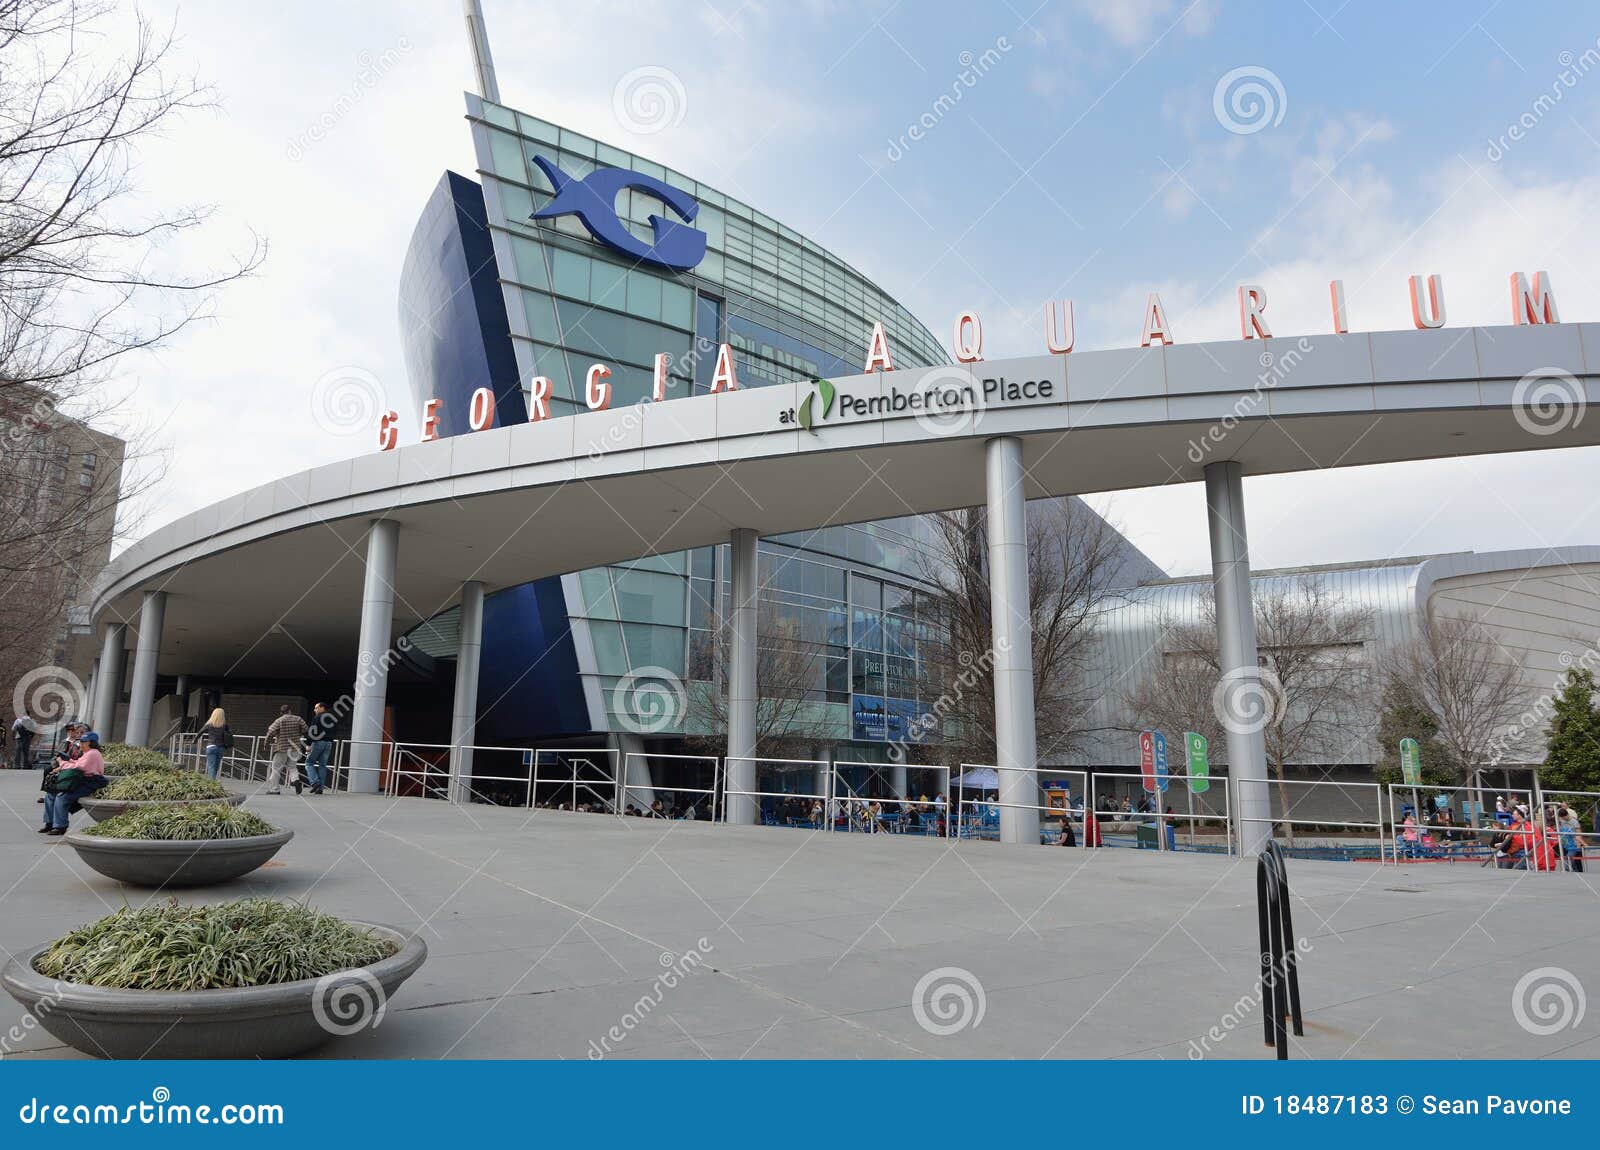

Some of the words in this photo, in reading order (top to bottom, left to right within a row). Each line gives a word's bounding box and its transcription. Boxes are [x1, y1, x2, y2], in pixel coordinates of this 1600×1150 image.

[377, 342, 738, 451] GEORGIA
[864, 270, 1561, 374] AQUARIUM
[779, 406, 796, 423] at
[839, 386, 974, 417] Pemberton
[982, 377, 1053, 402] Place
